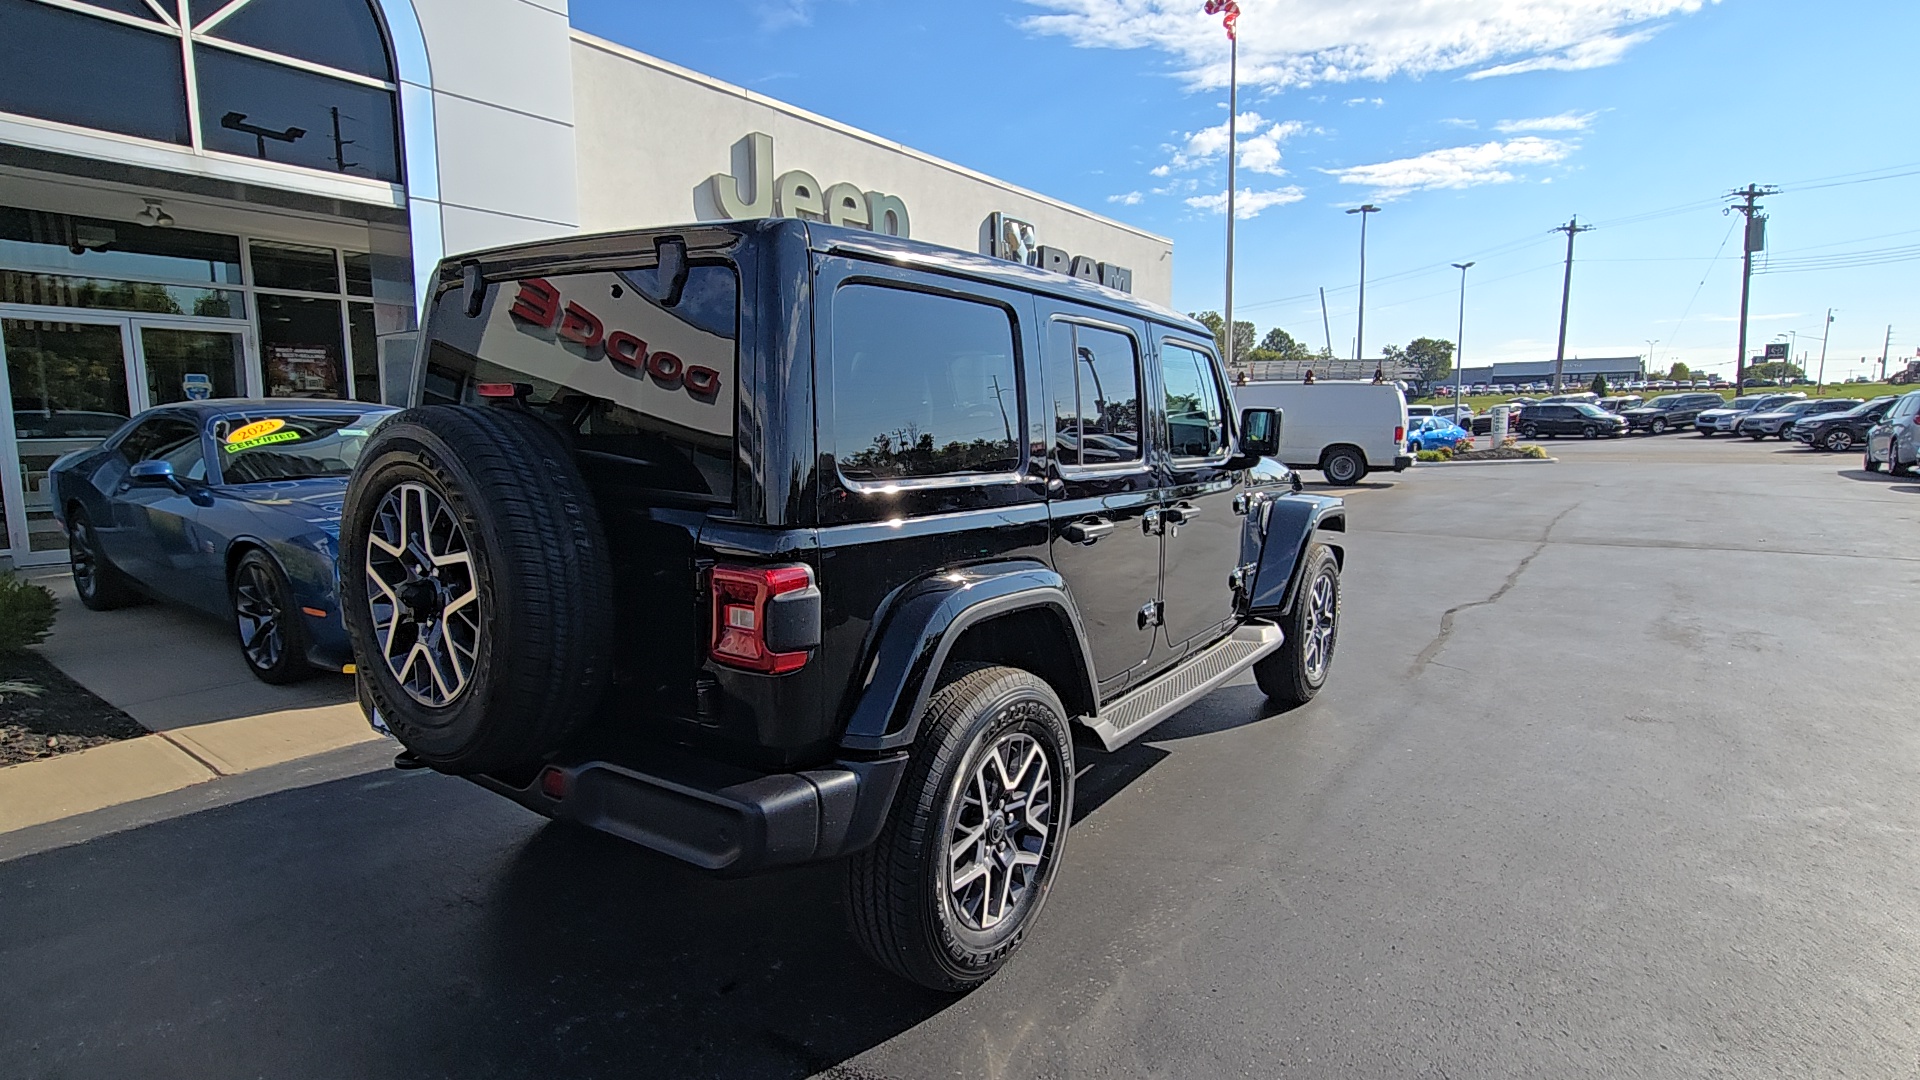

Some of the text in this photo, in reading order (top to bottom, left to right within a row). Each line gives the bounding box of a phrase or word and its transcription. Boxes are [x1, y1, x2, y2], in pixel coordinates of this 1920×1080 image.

[1040, 245, 1132, 294] RAM
[237, 421, 276, 440] 2023
[228, 432, 296, 452] CERTIFIED
